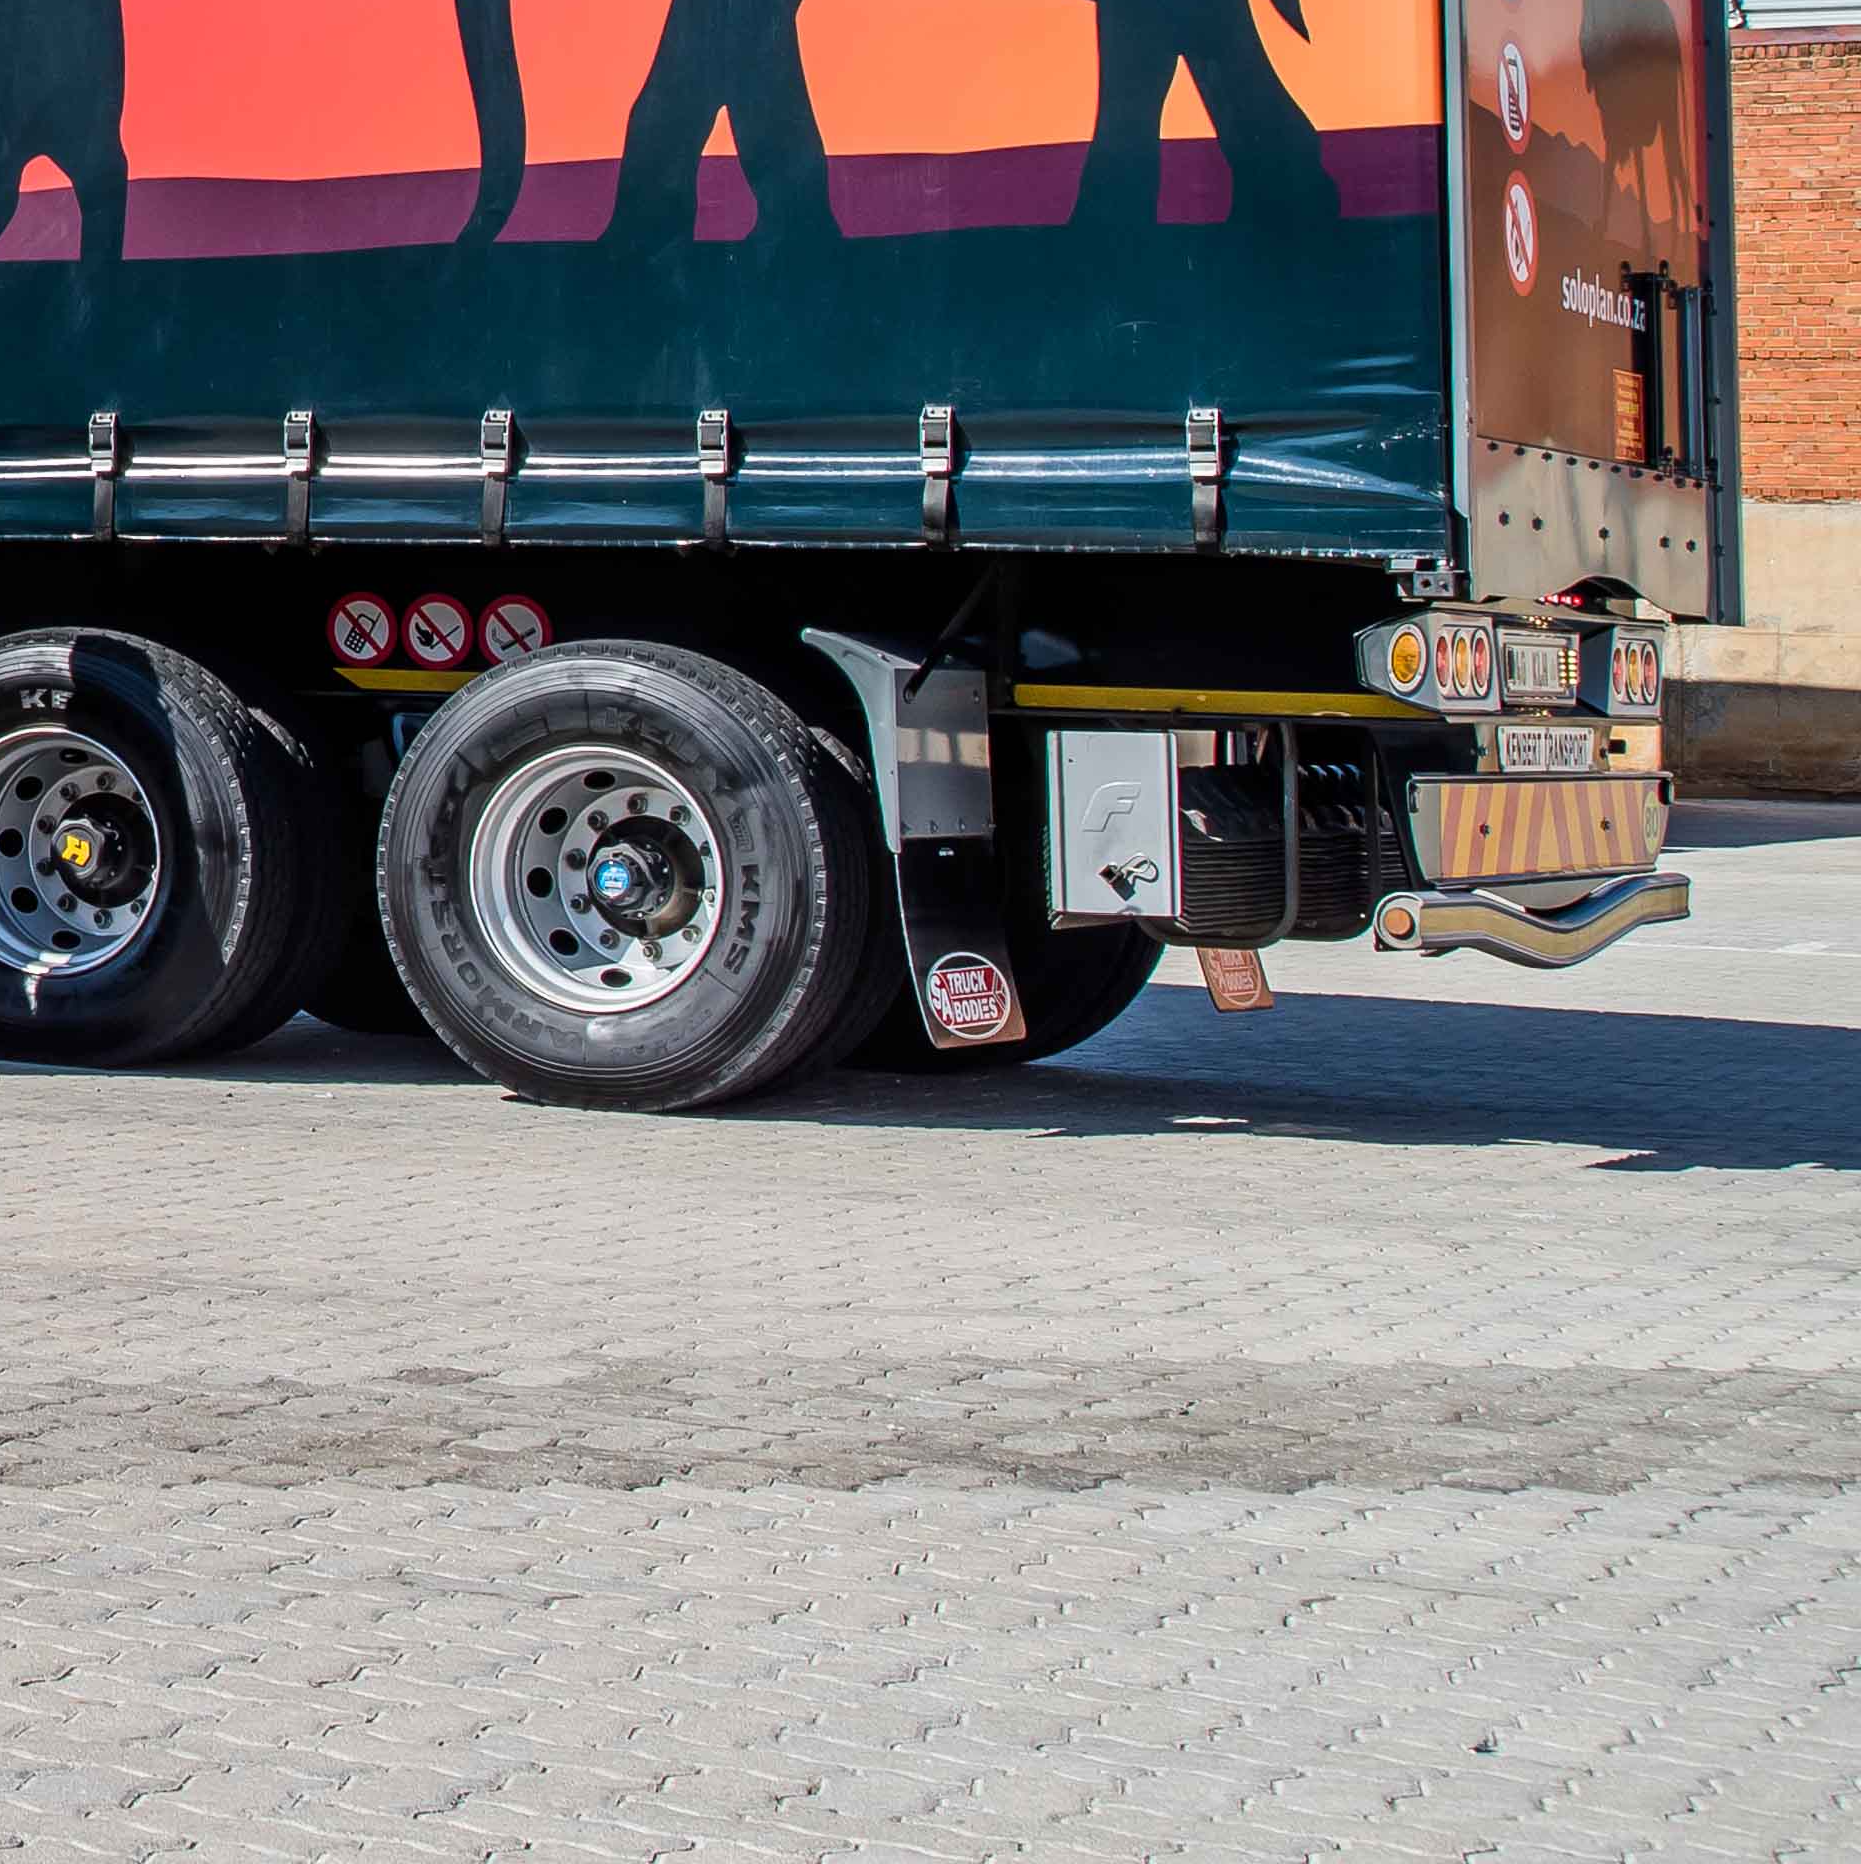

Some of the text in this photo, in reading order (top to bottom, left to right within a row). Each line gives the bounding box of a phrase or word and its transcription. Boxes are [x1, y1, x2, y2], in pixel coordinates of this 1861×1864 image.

[1562, 267, 1646, 332] soloplan.co.za
[1645, 806, 1659, 840] 80
[947, 970, 988, 995] TRUCK
[953, 996, 998, 1023] BODIES
